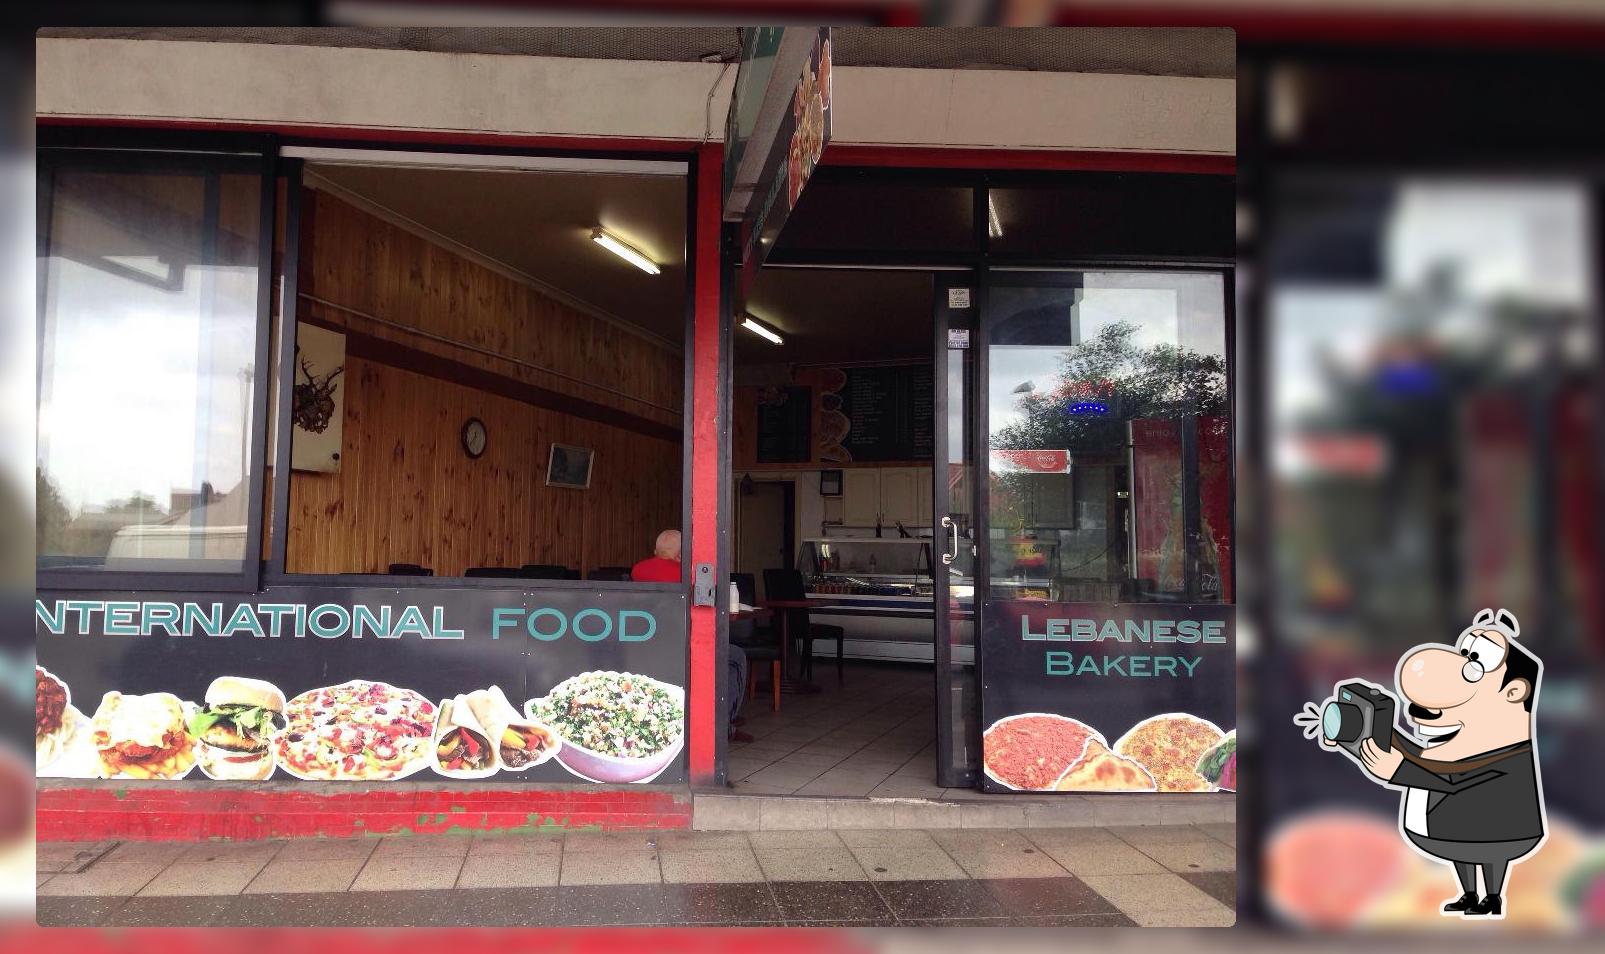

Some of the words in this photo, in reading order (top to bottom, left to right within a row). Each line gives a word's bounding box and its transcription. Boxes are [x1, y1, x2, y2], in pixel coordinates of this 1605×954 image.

[36, 600, 464, 640] NTERNATIONAL
[492, 607, 657, 642] FOOD
[1021, 614, 1227, 643] LEBANESE
[1046, 651, 1203, 677] BAKERY
